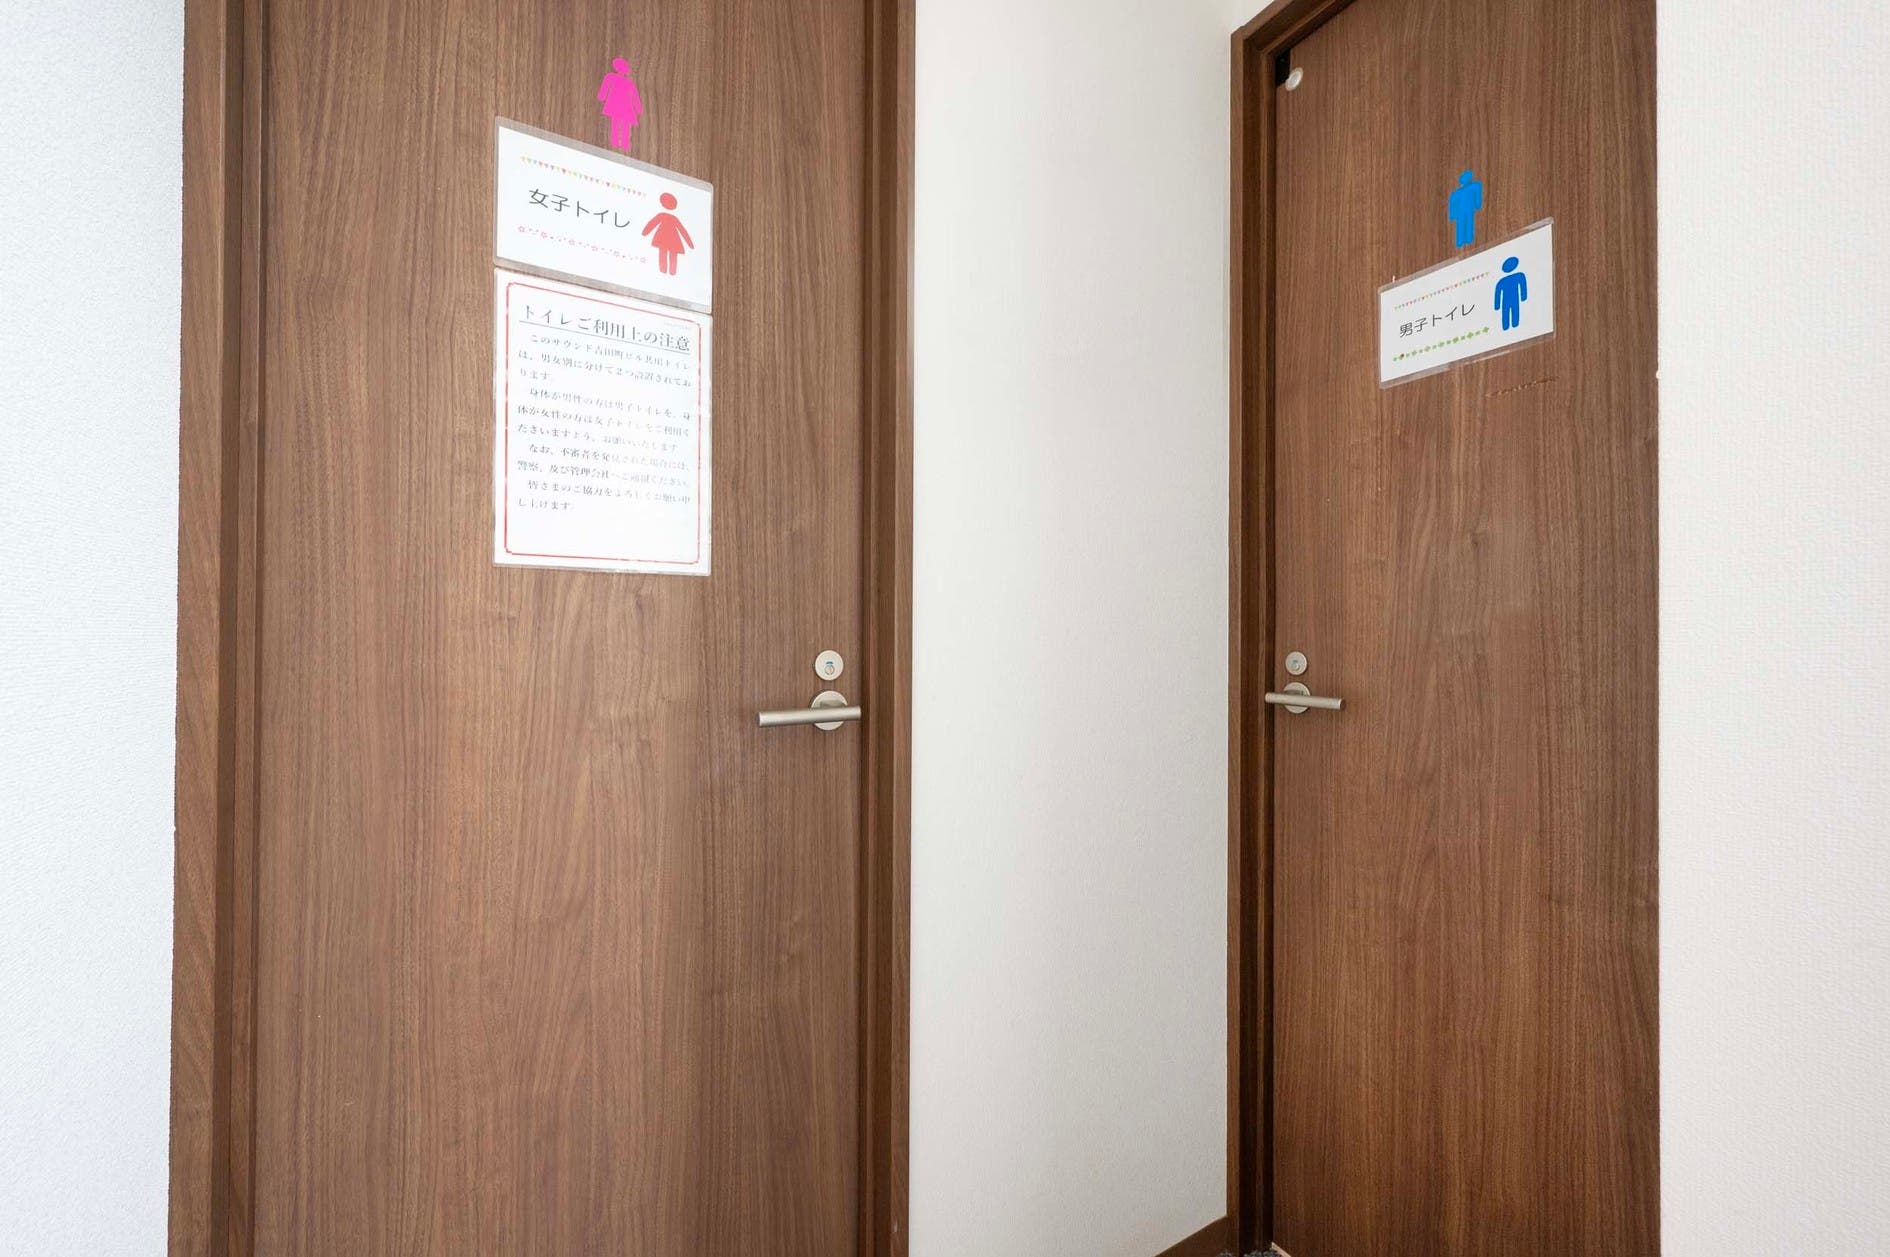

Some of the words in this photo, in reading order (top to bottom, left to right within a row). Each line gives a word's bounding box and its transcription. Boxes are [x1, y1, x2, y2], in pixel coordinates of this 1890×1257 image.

[528, 188, 630, 229] 女子トイレ
[526, 304, 690, 352] トイレご利用上の注意
[1399, 303, 1475, 338] 男子トイレ
